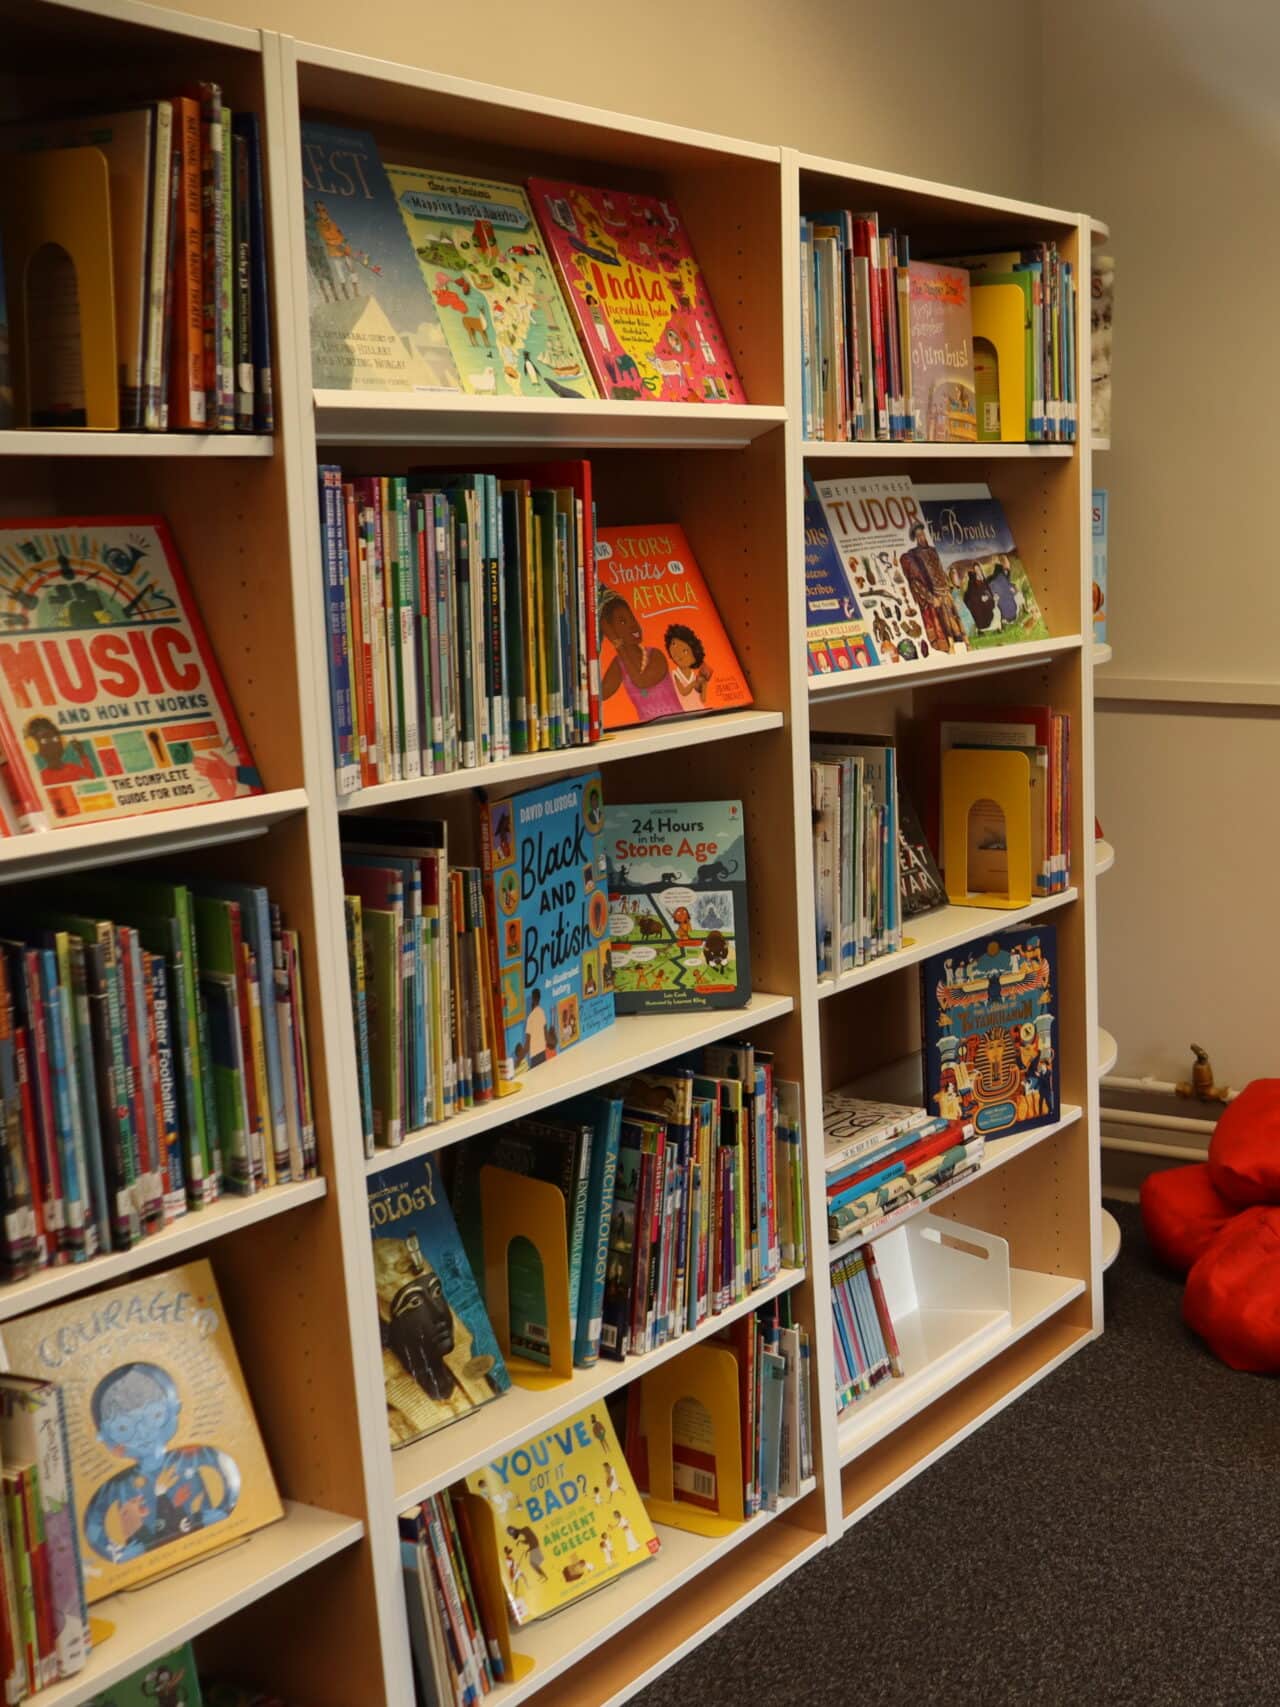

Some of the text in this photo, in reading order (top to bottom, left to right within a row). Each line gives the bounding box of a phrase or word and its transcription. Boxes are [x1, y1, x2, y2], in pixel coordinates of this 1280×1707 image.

[590, 261, 667, 302] India
[912, 339, 969, 372] olumbus!
[827, 496, 922, 536] TUDOR
[616, 534, 673, 561] STORY
[608, 560, 667, 585] Starts
[632, 580, 698, 611] AFRICA
[0, 626, 201, 709] MUSIC
[57, 694, 209, 727] AND HOW IT WORKS
[111, 768, 191, 792] THE COMPLETE
[117, 783, 196, 806] GUIDE FOR KIDS
[520, 791, 578, 823] DAVID OLUSOGA
[631, 817, 705, 834] 24 Hours
[638, 833, 666, 844] in the
[520, 812, 588, 901] Black
[615, 837, 718, 864] Stone Age
[540, 880, 577, 916] AND
[524, 901, 592, 989] British
[153, 999, 176, 1125] Better Footballer
[572, 1180, 588, 1252] ENCYCLOPEDIA
[594, 1151, 616, 1285] ARCHAEOLOGY
[38, 1290, 194, 1369] COURAGE
[490, 1421, 592, 1484] YOU'VE
[525, 1473, 588, 1523] BAD?
[530, 1470, 551, 1492] GOT
[543, 1511, 597, 1547] ANCIENT
[552, 1527, 598, 1557] GREECE
